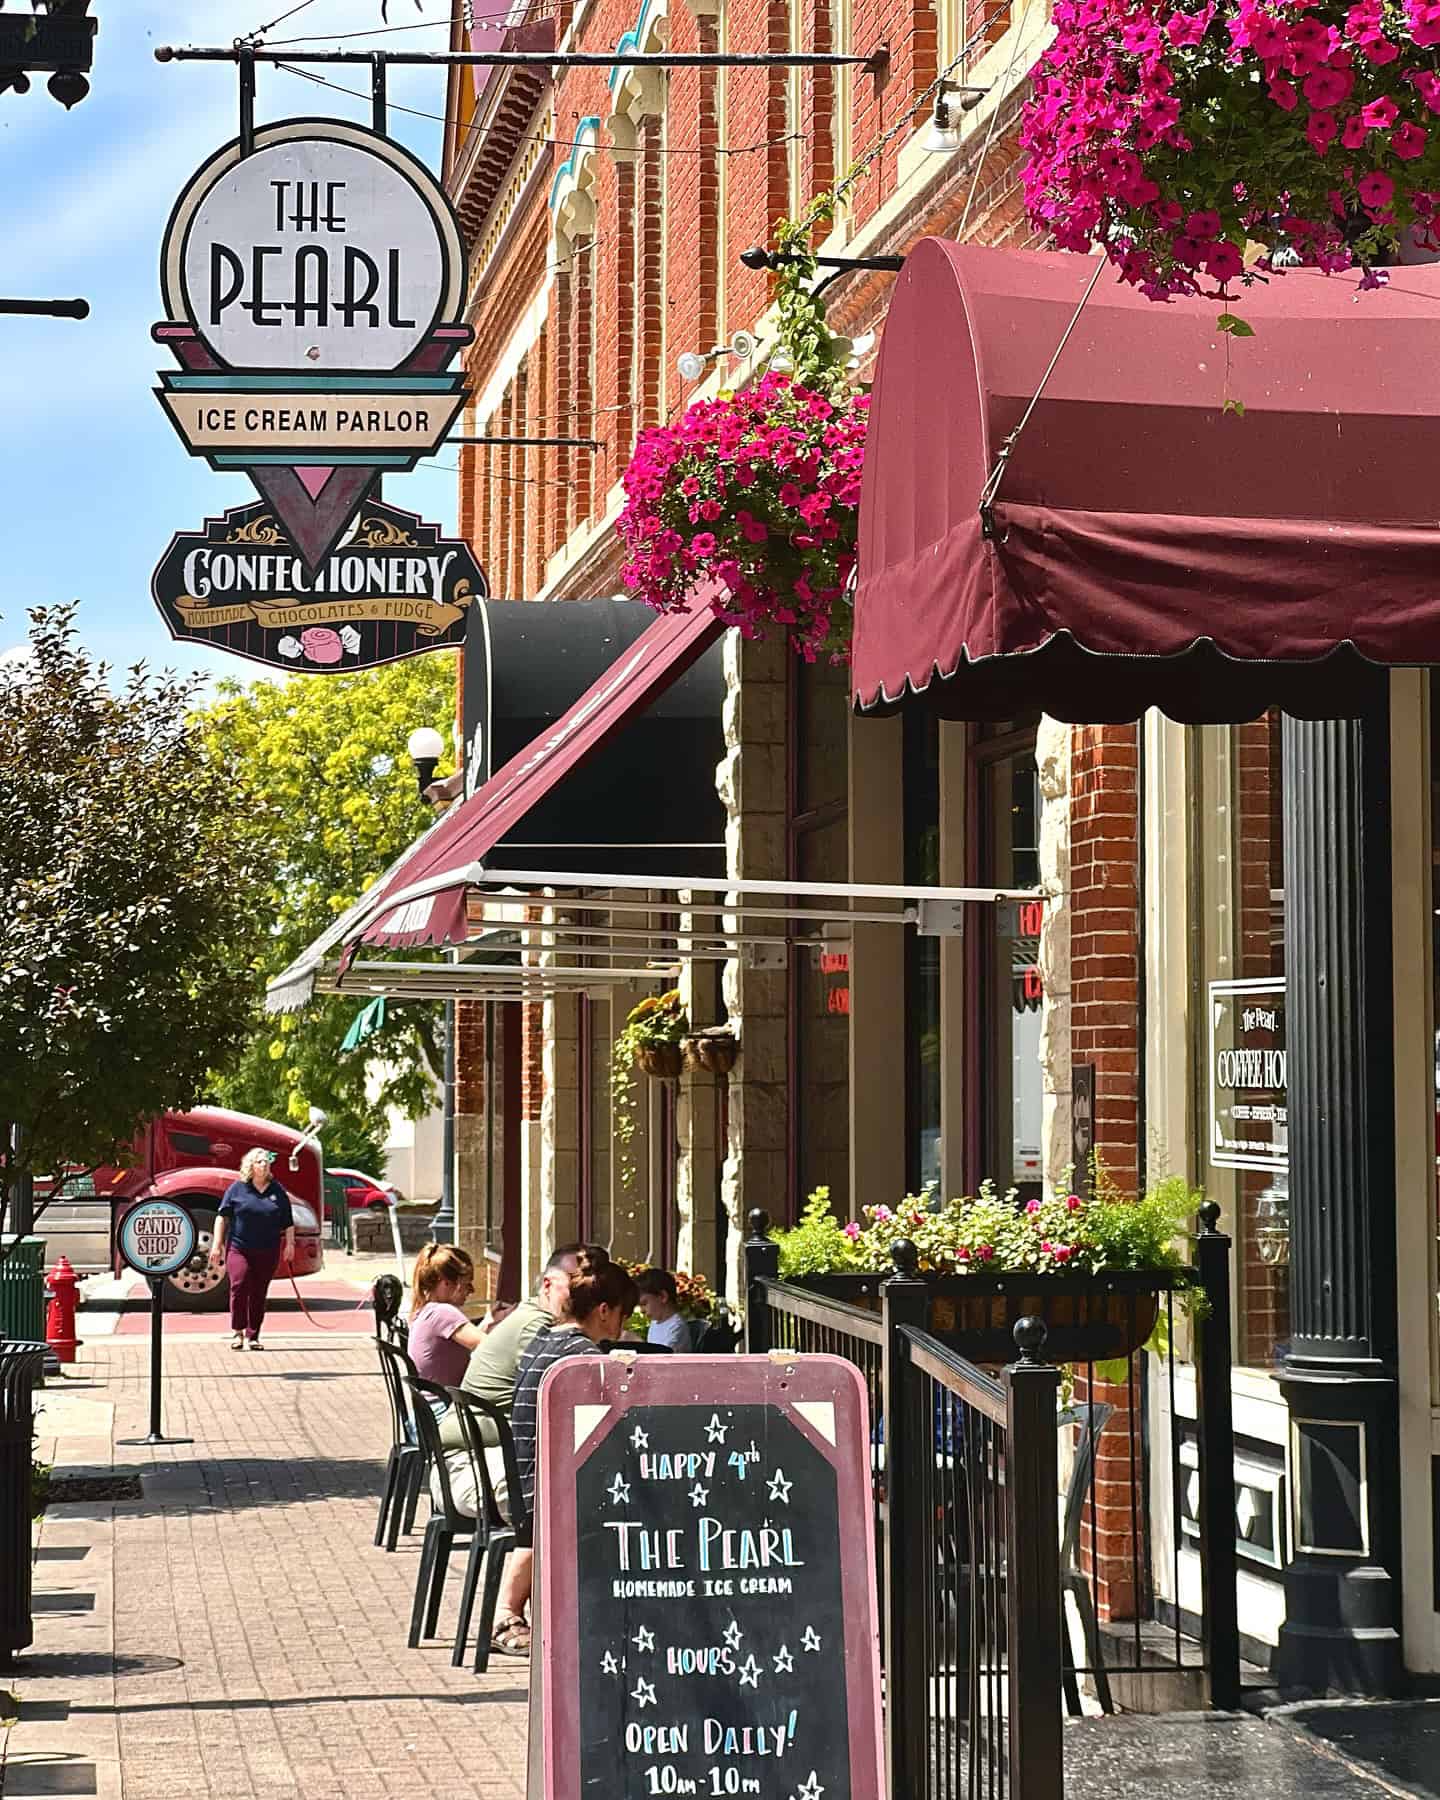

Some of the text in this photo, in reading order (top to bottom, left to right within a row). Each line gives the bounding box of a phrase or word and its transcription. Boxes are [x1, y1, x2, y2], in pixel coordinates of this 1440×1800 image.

[270, 180, 347, 233] THE
[209, 241, 416, 328] PEARL
[197, 409, 429, 432] ICE CREAM PARLOR
[268, 603, 364, 625] CHOCOLATES
[385, 603, 433, 620] FUDGE
[1217, 1050, 1263, 1088] COFFEE
[133, 1216, 183, 1236] CANDY
[138, 1236, 177, 1255] SHOP
[640, 1452, 716, 1480] HAPPY
[603, 1517, 805, 1571] THE PEARL
[613, 1578, 793, 1598] HOMEMADE ICE CREAM
[667, 1647, 736, 1676] HOURS
[625, 1709, 798, 1758] OPEN DAILY!
